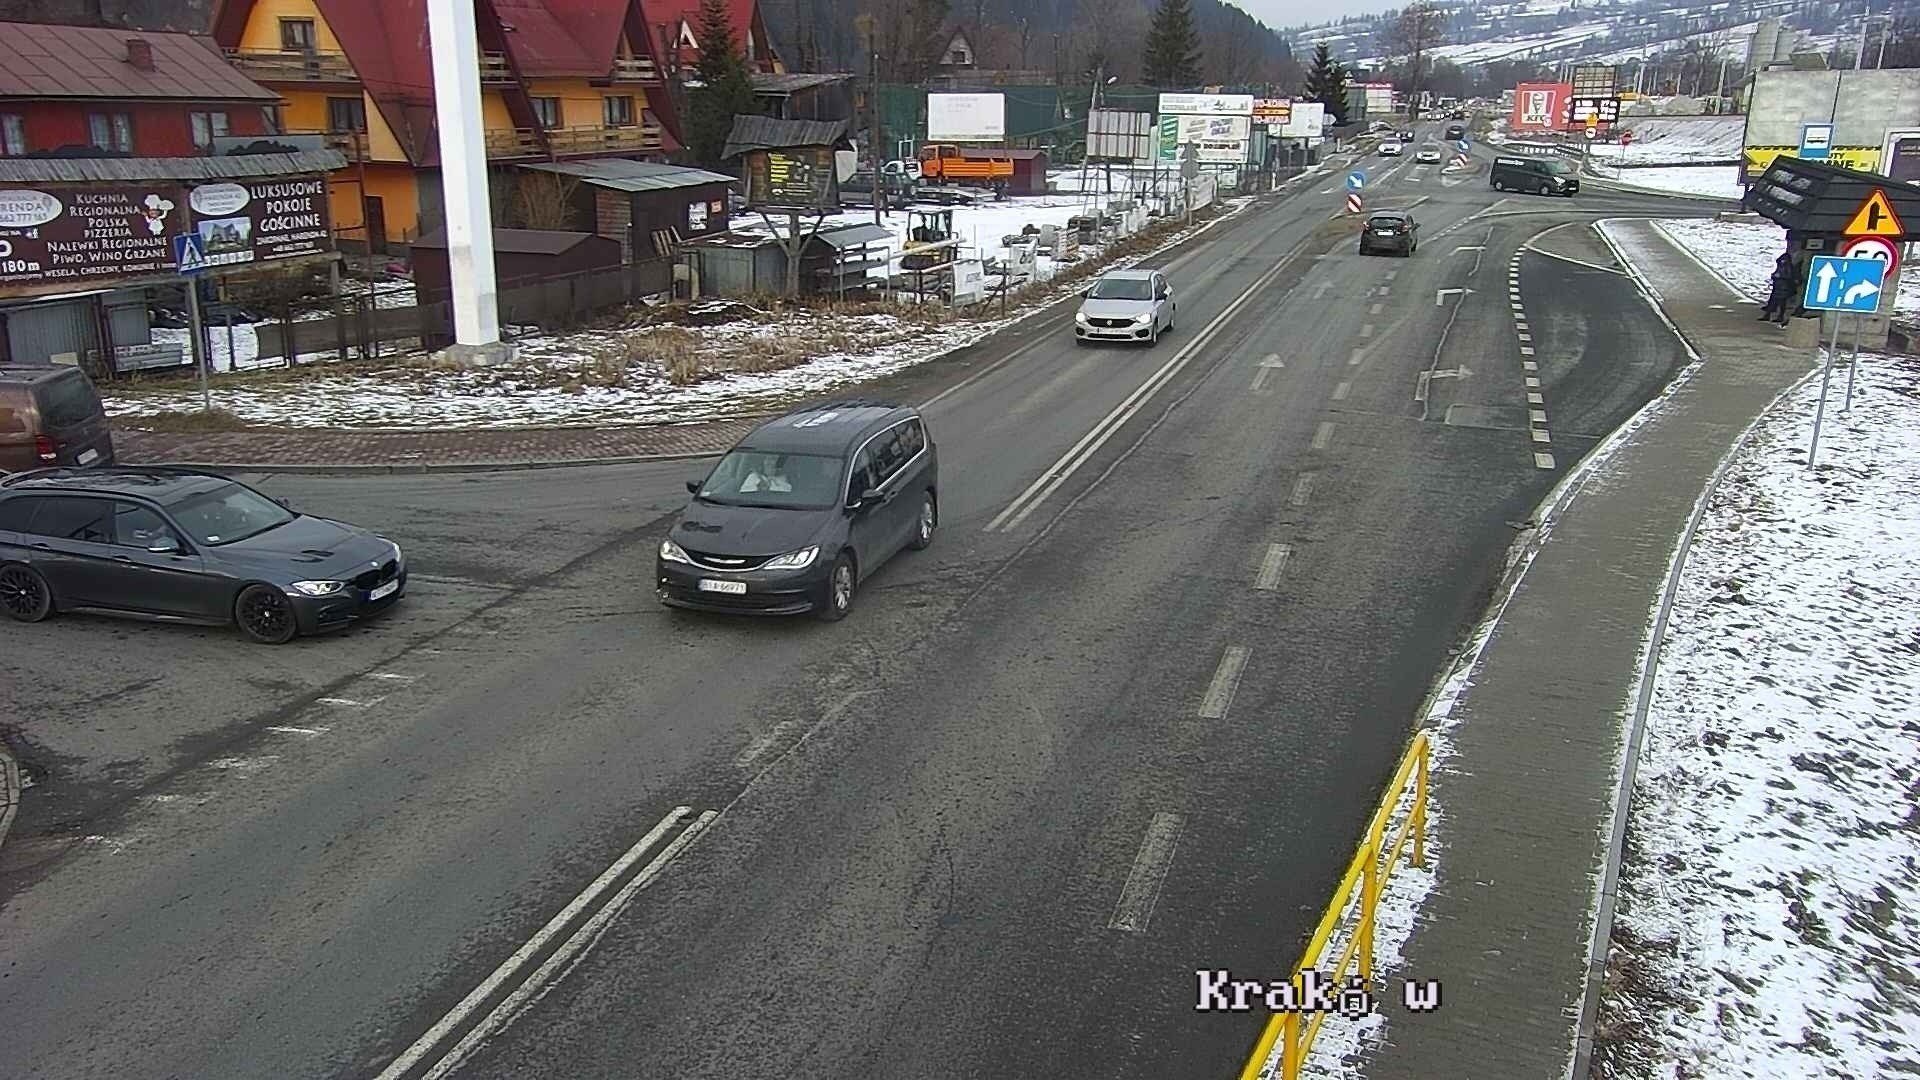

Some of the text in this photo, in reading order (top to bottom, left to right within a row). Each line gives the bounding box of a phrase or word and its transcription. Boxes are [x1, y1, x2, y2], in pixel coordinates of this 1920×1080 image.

[251, 181, 324, 199] LUKSUSOWE
[76, 194, 129, 204] KUCHNIA
[69, 205, 141, 216] REGIONALNA
[266, 198, 312, 214] POKOJE
[88, 218, 130, 228] POLSKA
[260, 213, 321, 232] GOŚCINNE
[84, 228, 132, 238] PIZZERIA
[47, 236, 168, 252] NALEWKI REGIONALNE
[89, 250, 122, 262] WINO
[124, 247, 168, 260] GRZANE
[2, 260, 41, 272] 180 m
